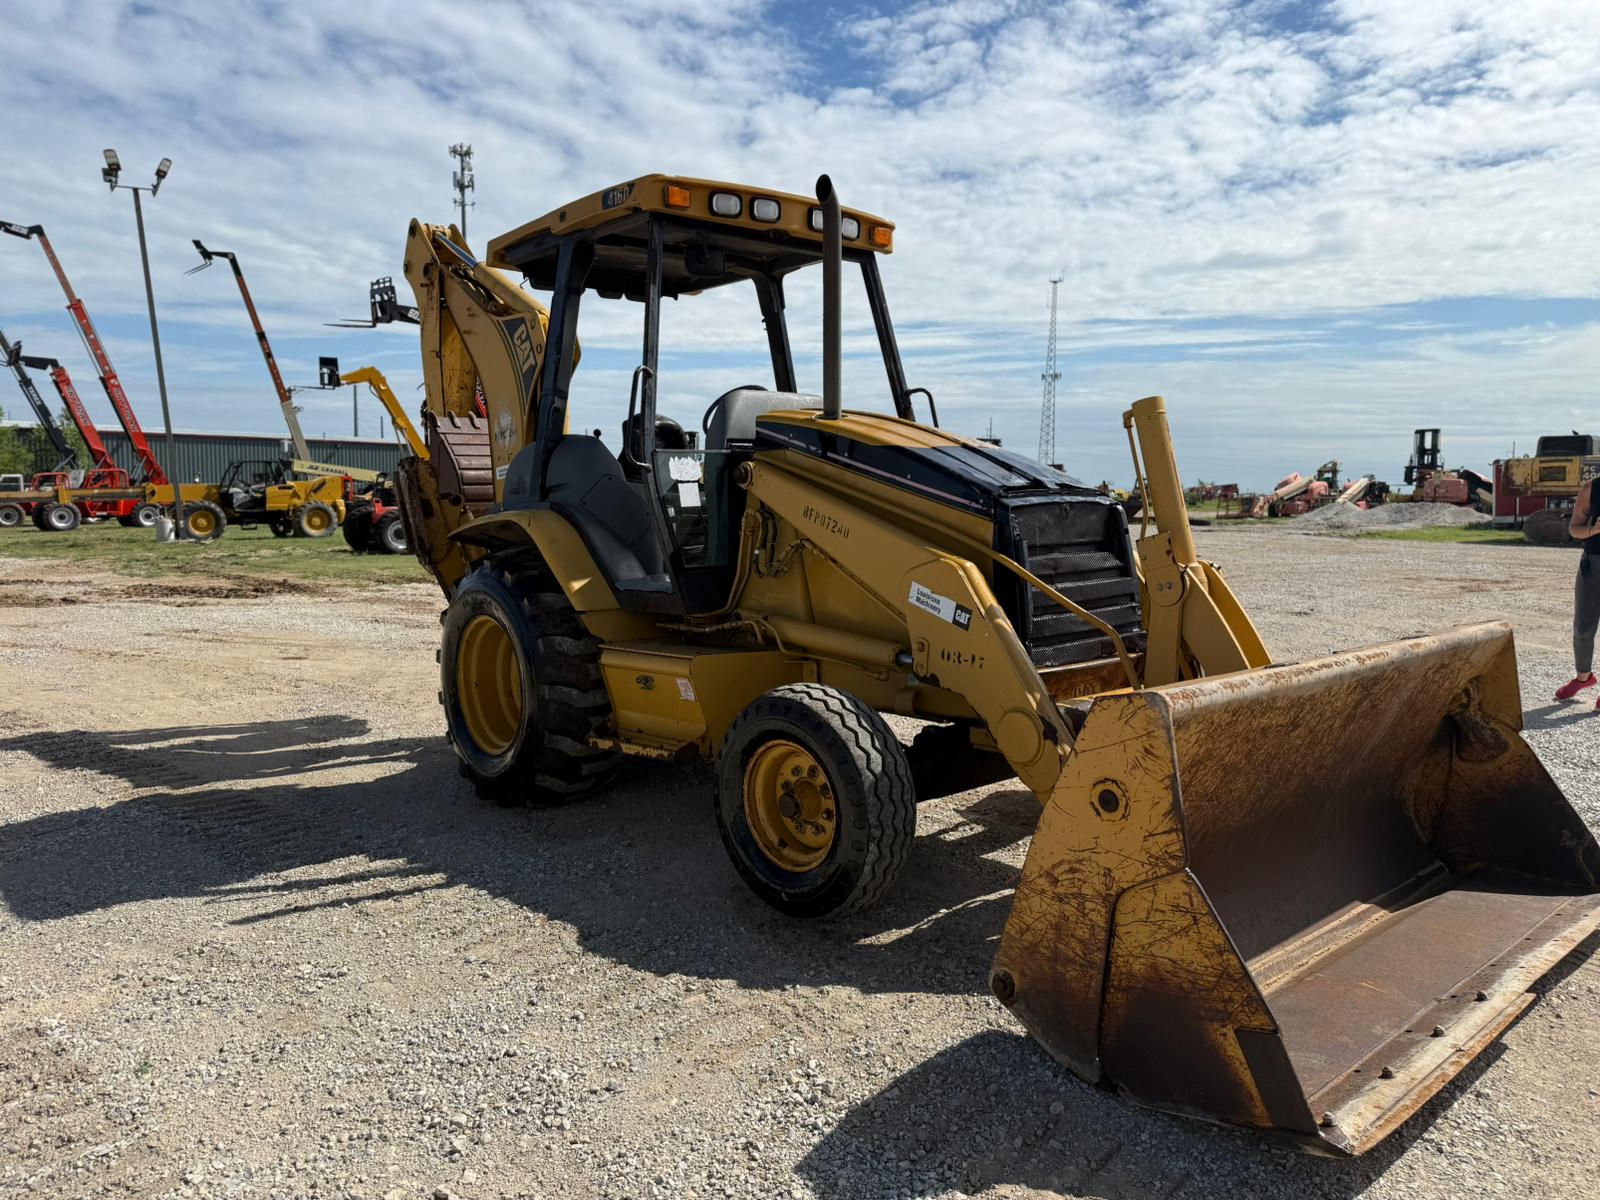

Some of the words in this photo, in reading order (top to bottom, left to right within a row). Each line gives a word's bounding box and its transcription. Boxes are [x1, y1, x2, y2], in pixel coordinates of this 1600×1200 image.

[408, 308, 420, 321] 60
[514, 323, 536, 374] CAT
[955, 609, 970, 625] CAT
